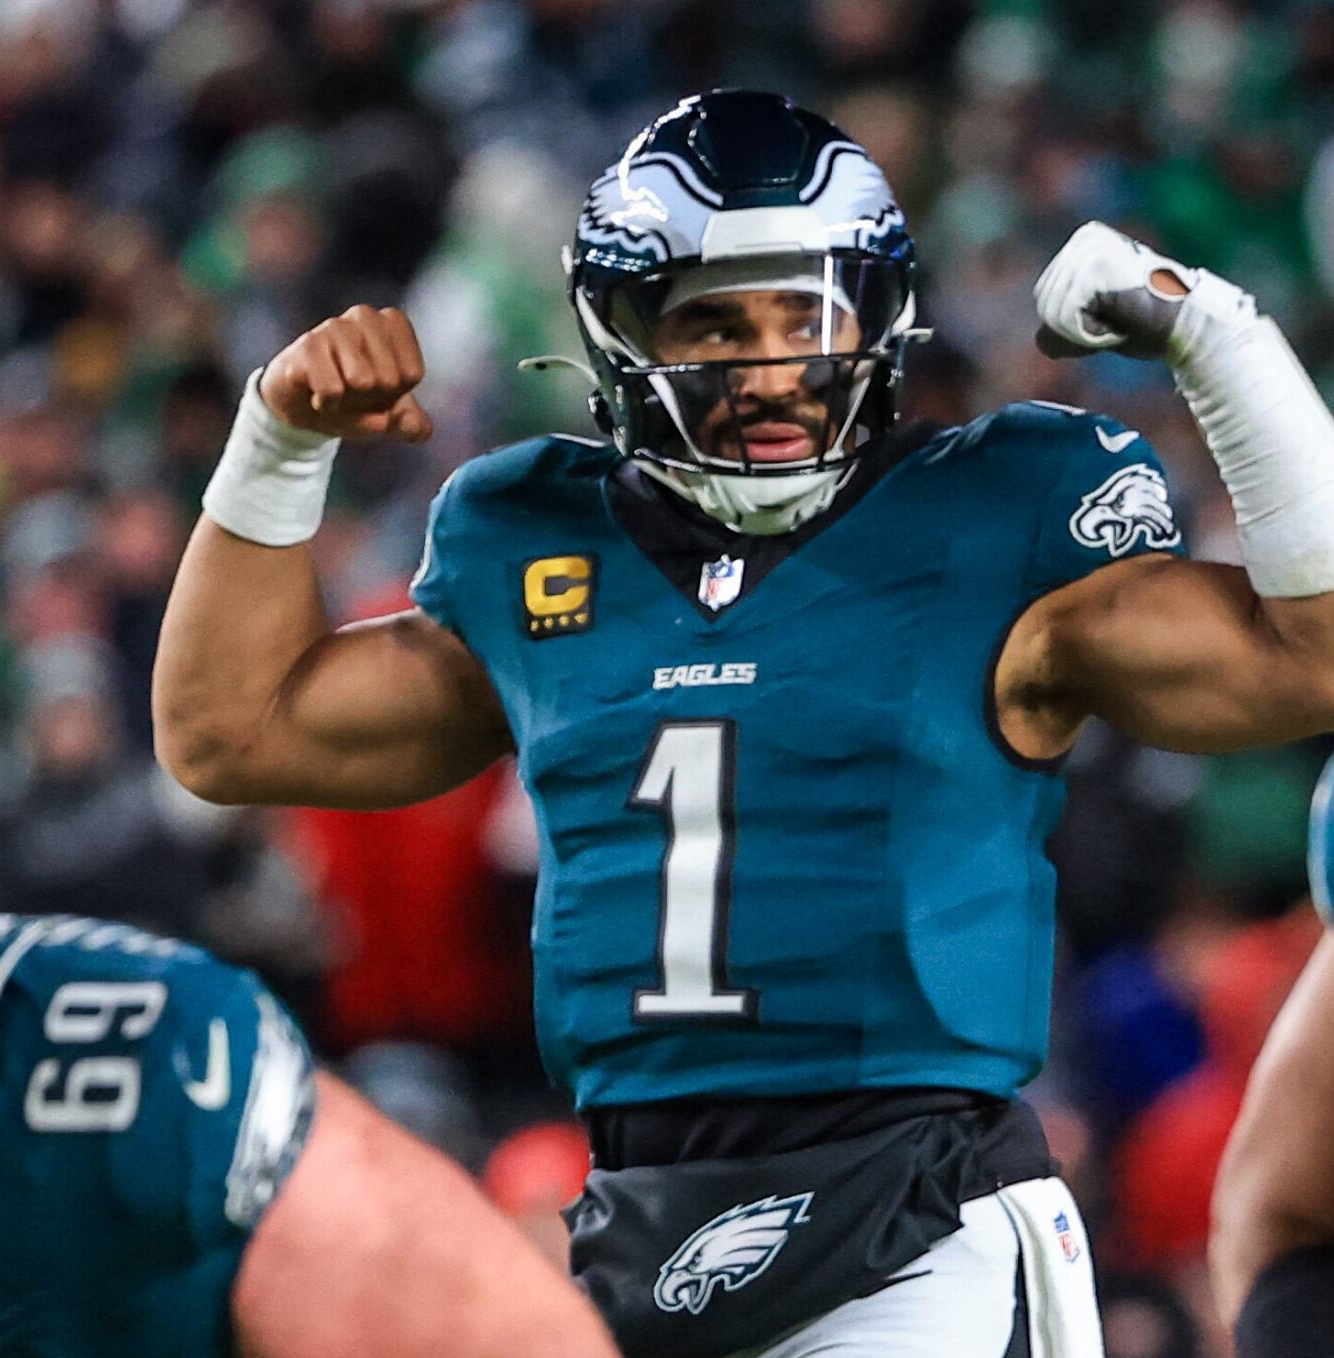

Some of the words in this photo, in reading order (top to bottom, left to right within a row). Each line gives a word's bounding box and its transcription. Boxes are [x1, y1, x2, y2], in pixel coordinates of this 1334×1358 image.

[524, 555, 591, 617] C
[652, 662, 758, 690] EAGLES
[627, 718, 753, 1020] 1
[23, 980, 169, 1133] 69
